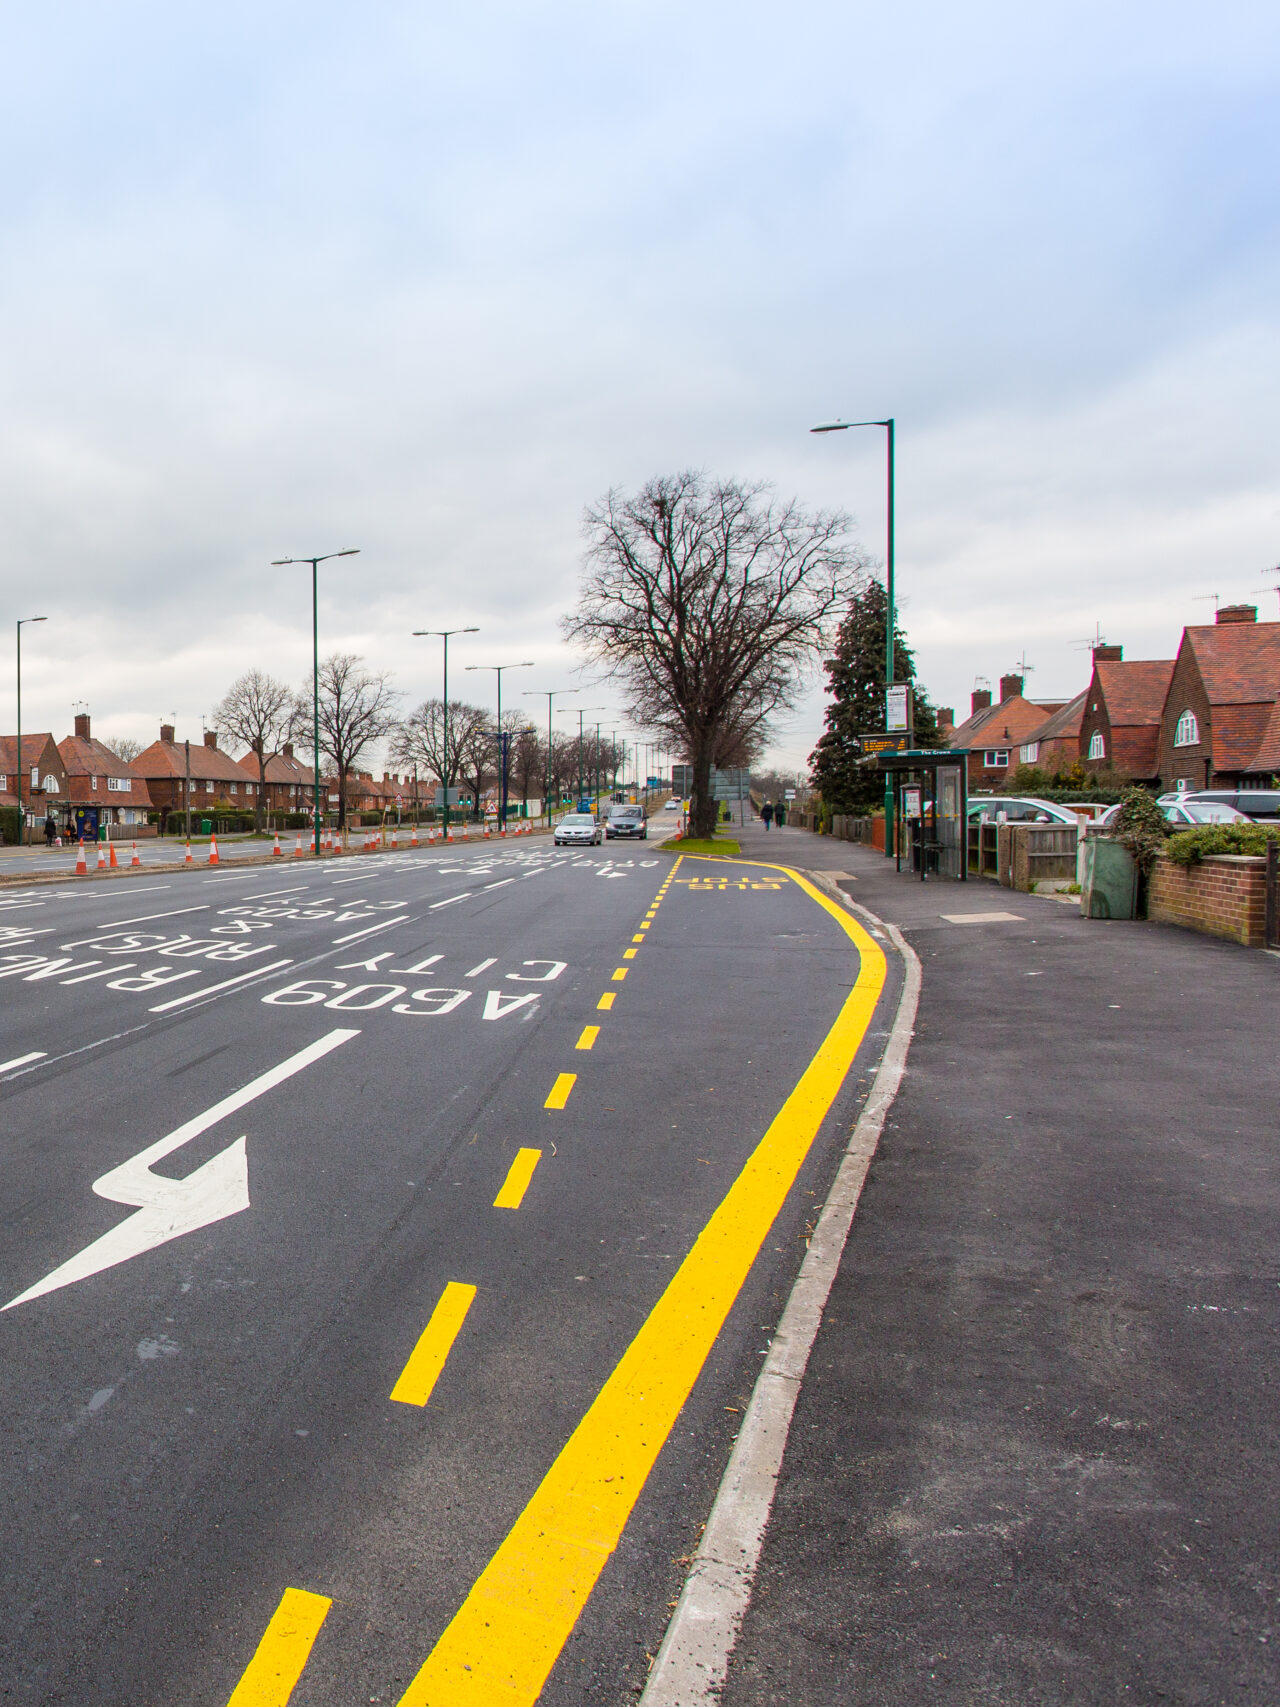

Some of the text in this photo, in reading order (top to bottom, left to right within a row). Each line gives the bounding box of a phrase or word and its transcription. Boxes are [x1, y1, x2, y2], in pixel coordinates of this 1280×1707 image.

[263, 897, 409, 910] CITY
[217, 907, 376, 922] A609
[210, 919, 274, 934] &
[59, 932, 277, 960] RD(S)
[334, 952, 568, 982] CITY
[261, 980, 542, 1020] A609
